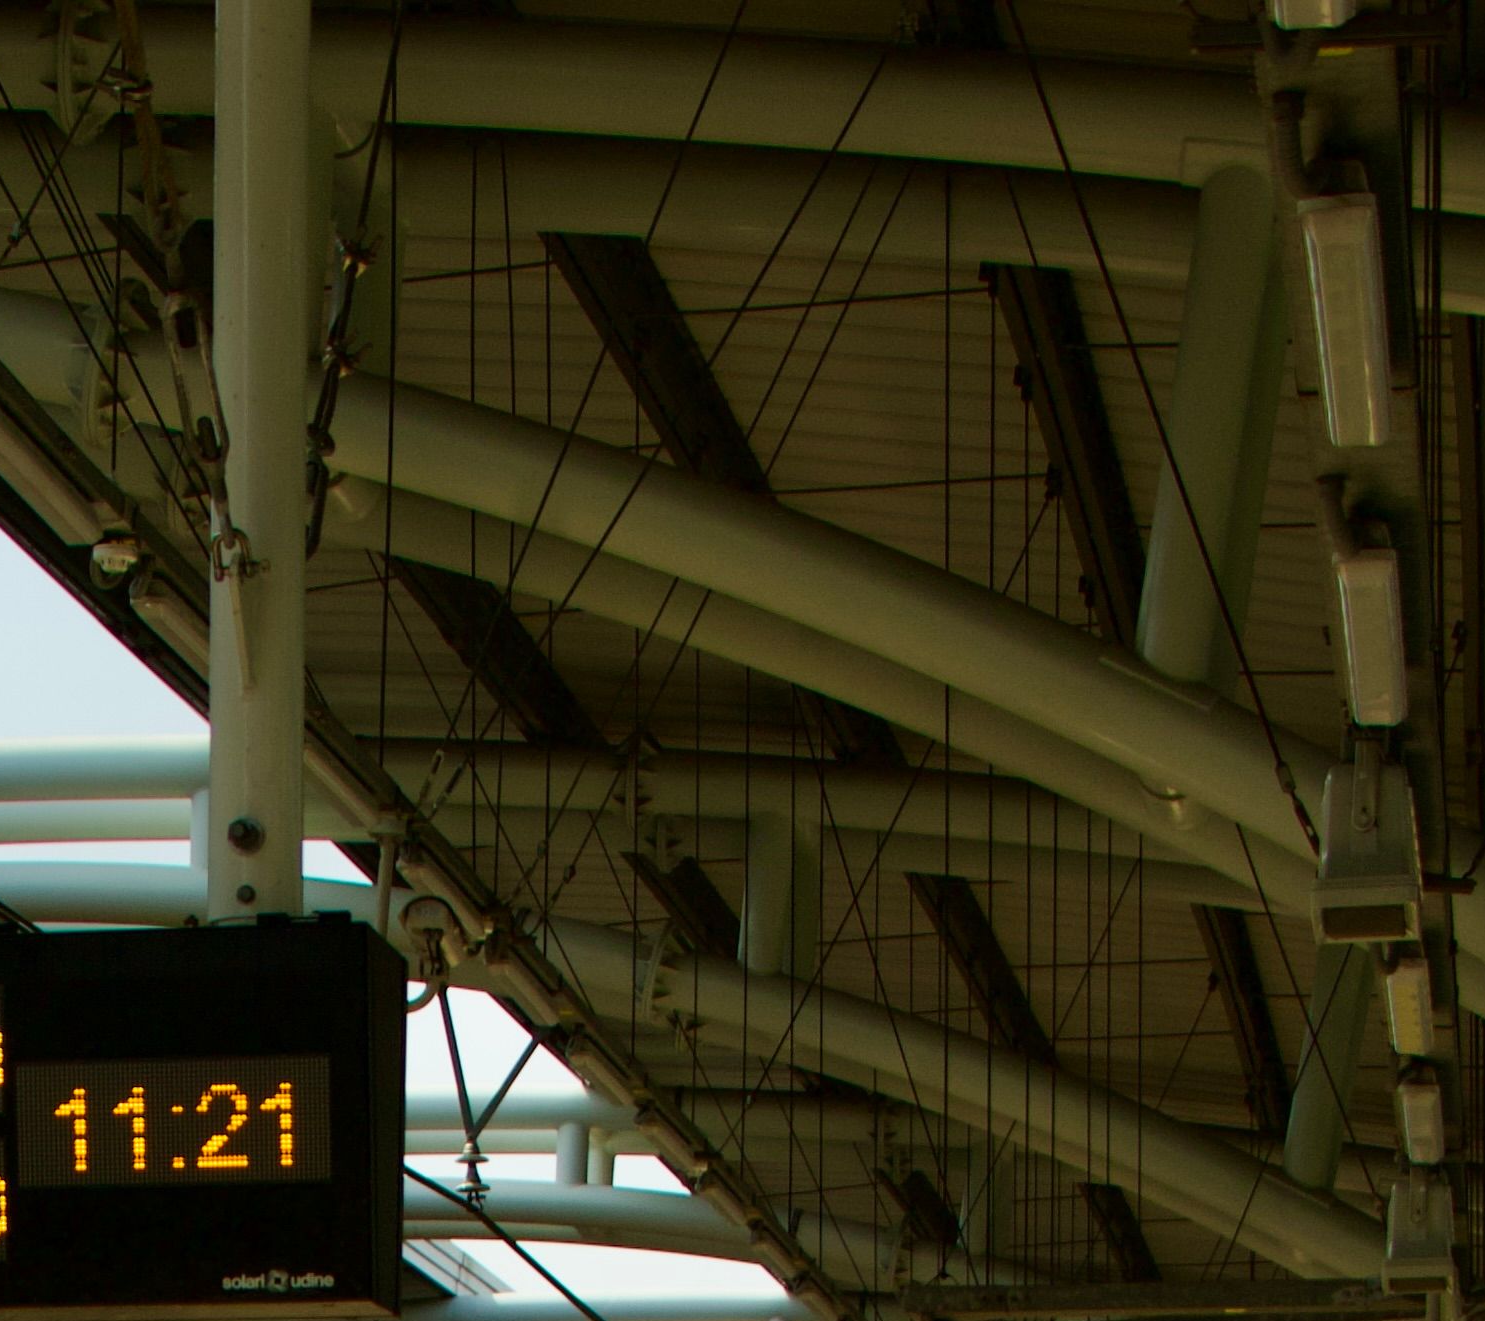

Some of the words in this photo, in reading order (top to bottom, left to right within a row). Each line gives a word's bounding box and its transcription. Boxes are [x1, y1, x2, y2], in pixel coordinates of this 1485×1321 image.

[54, 1081, 298, 1172] 11:21
[222, 1273, 266, 1290] solari
[290, 1271, 335, 1288] udine
